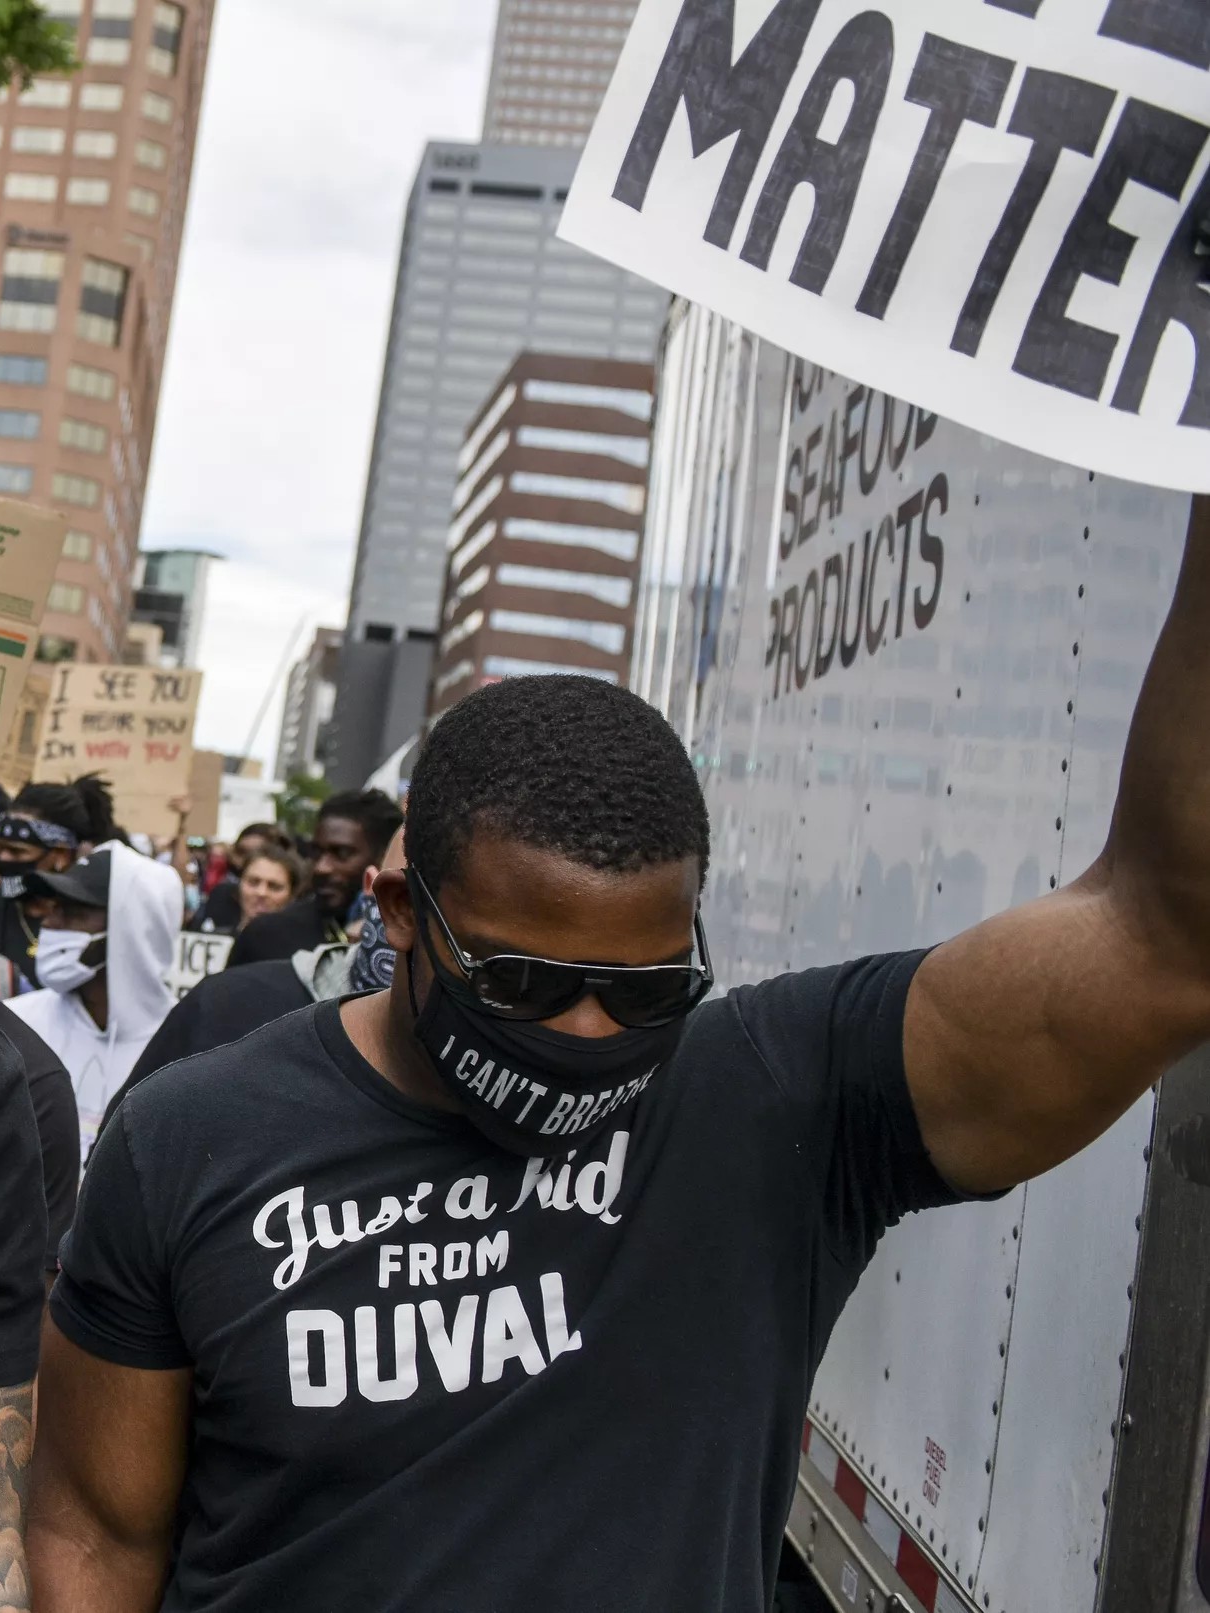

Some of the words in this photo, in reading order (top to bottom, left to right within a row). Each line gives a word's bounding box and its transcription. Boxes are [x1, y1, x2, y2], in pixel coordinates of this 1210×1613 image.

[766, 472, 949, 700] PRODUCTS
[49, 710, 66, 733] I
[142, 716, 187, 737] YOU
[55, 670, 71, 703] I
[95, 670, 137, 700] SEE
[150, 674, 192, 703] YOU
[440, 1035, 455, 1060] I
[455, 1049, 548, 1125] CAN'T
[539, 1063, 661, 1135] BREATHE
[252, 1182, 433, 1290] Just
[444, 1175, 498, 1220] a
[378, 1230, 509, 1288] FROM
[286, 1272, 582, 1407] DUVAL
[925, 1459, 941, 1489] FUEL
